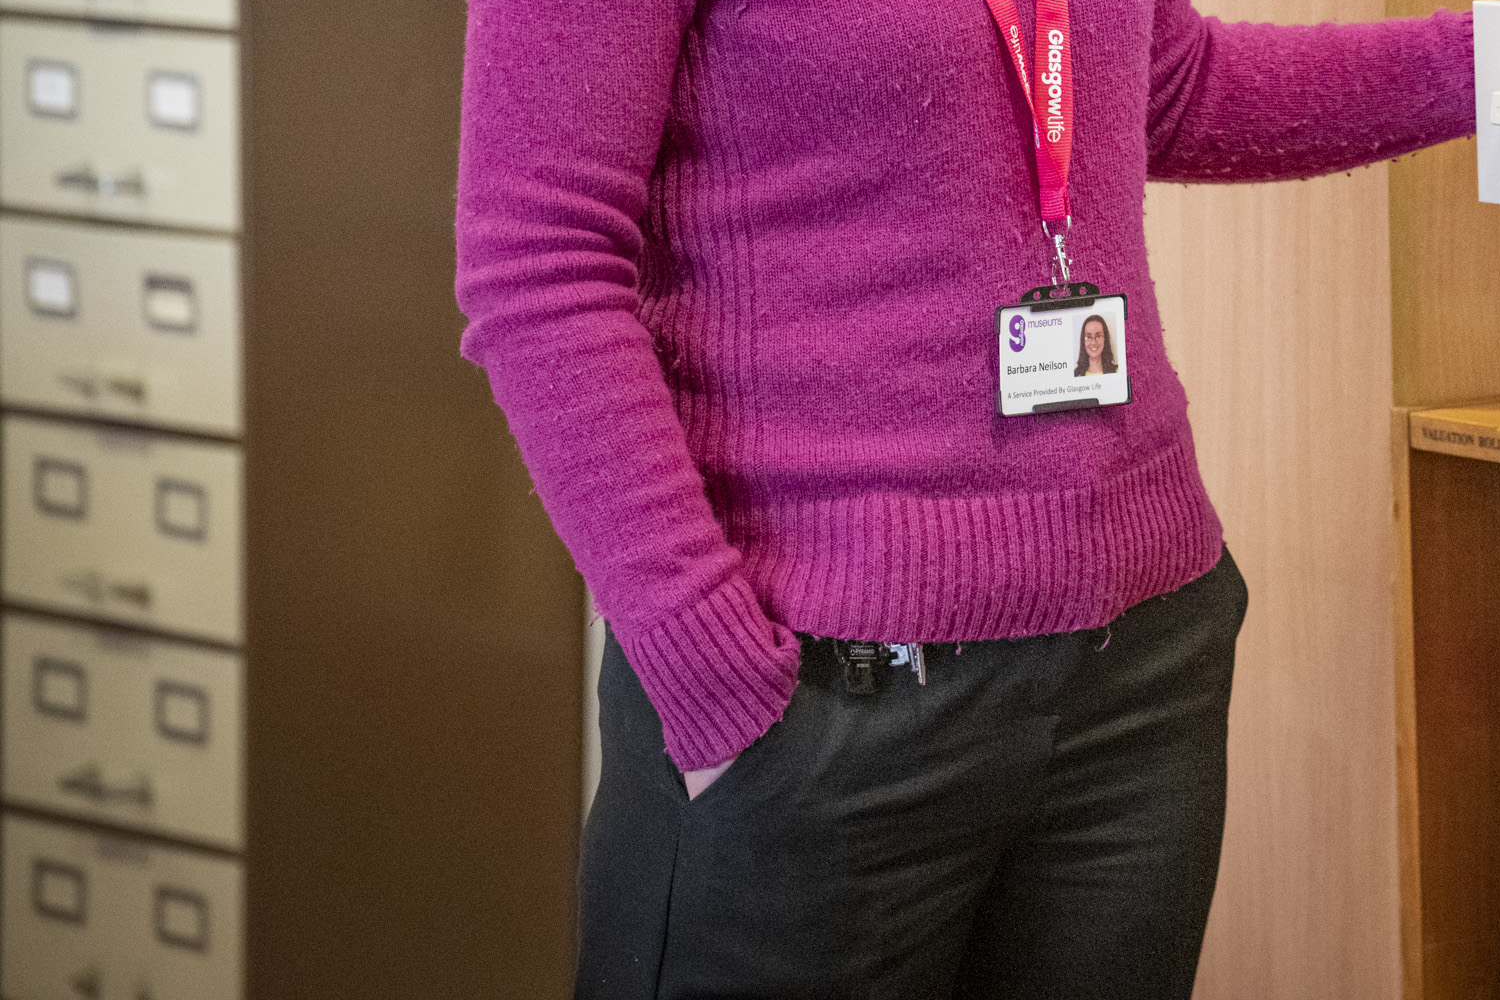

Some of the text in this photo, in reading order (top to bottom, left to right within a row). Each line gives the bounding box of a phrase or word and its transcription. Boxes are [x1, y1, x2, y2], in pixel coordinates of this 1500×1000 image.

[1041, 29, 1065, 143] Glasgowlife
[1027, 317, 1063, 329] museums
[1007, 361, 1068, 375] Barbara Neilson
[1012, 391, 1032, 399] Service
[1033, 388, 1058, 396] Provided
[1058, 387, 1066, 395] By
[1066, 384, 1090, 394] Glasgow
